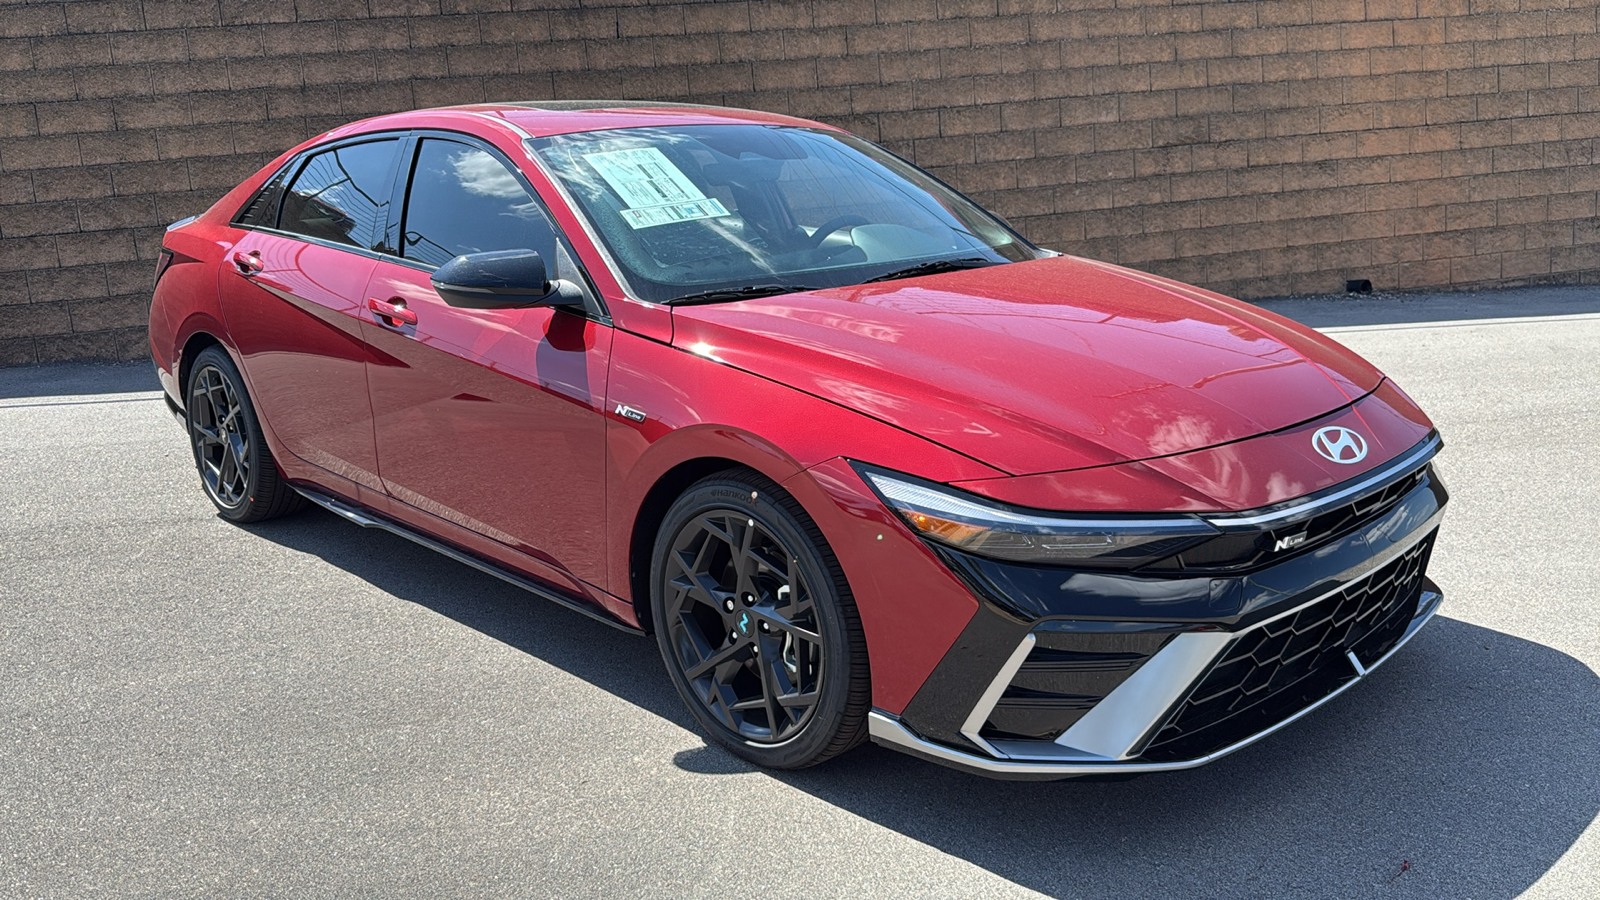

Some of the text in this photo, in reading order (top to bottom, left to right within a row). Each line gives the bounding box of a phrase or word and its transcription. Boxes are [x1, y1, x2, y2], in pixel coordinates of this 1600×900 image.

[615, 404, 642, 420] N Line
[1274, 536, 1303, 552] N Line
